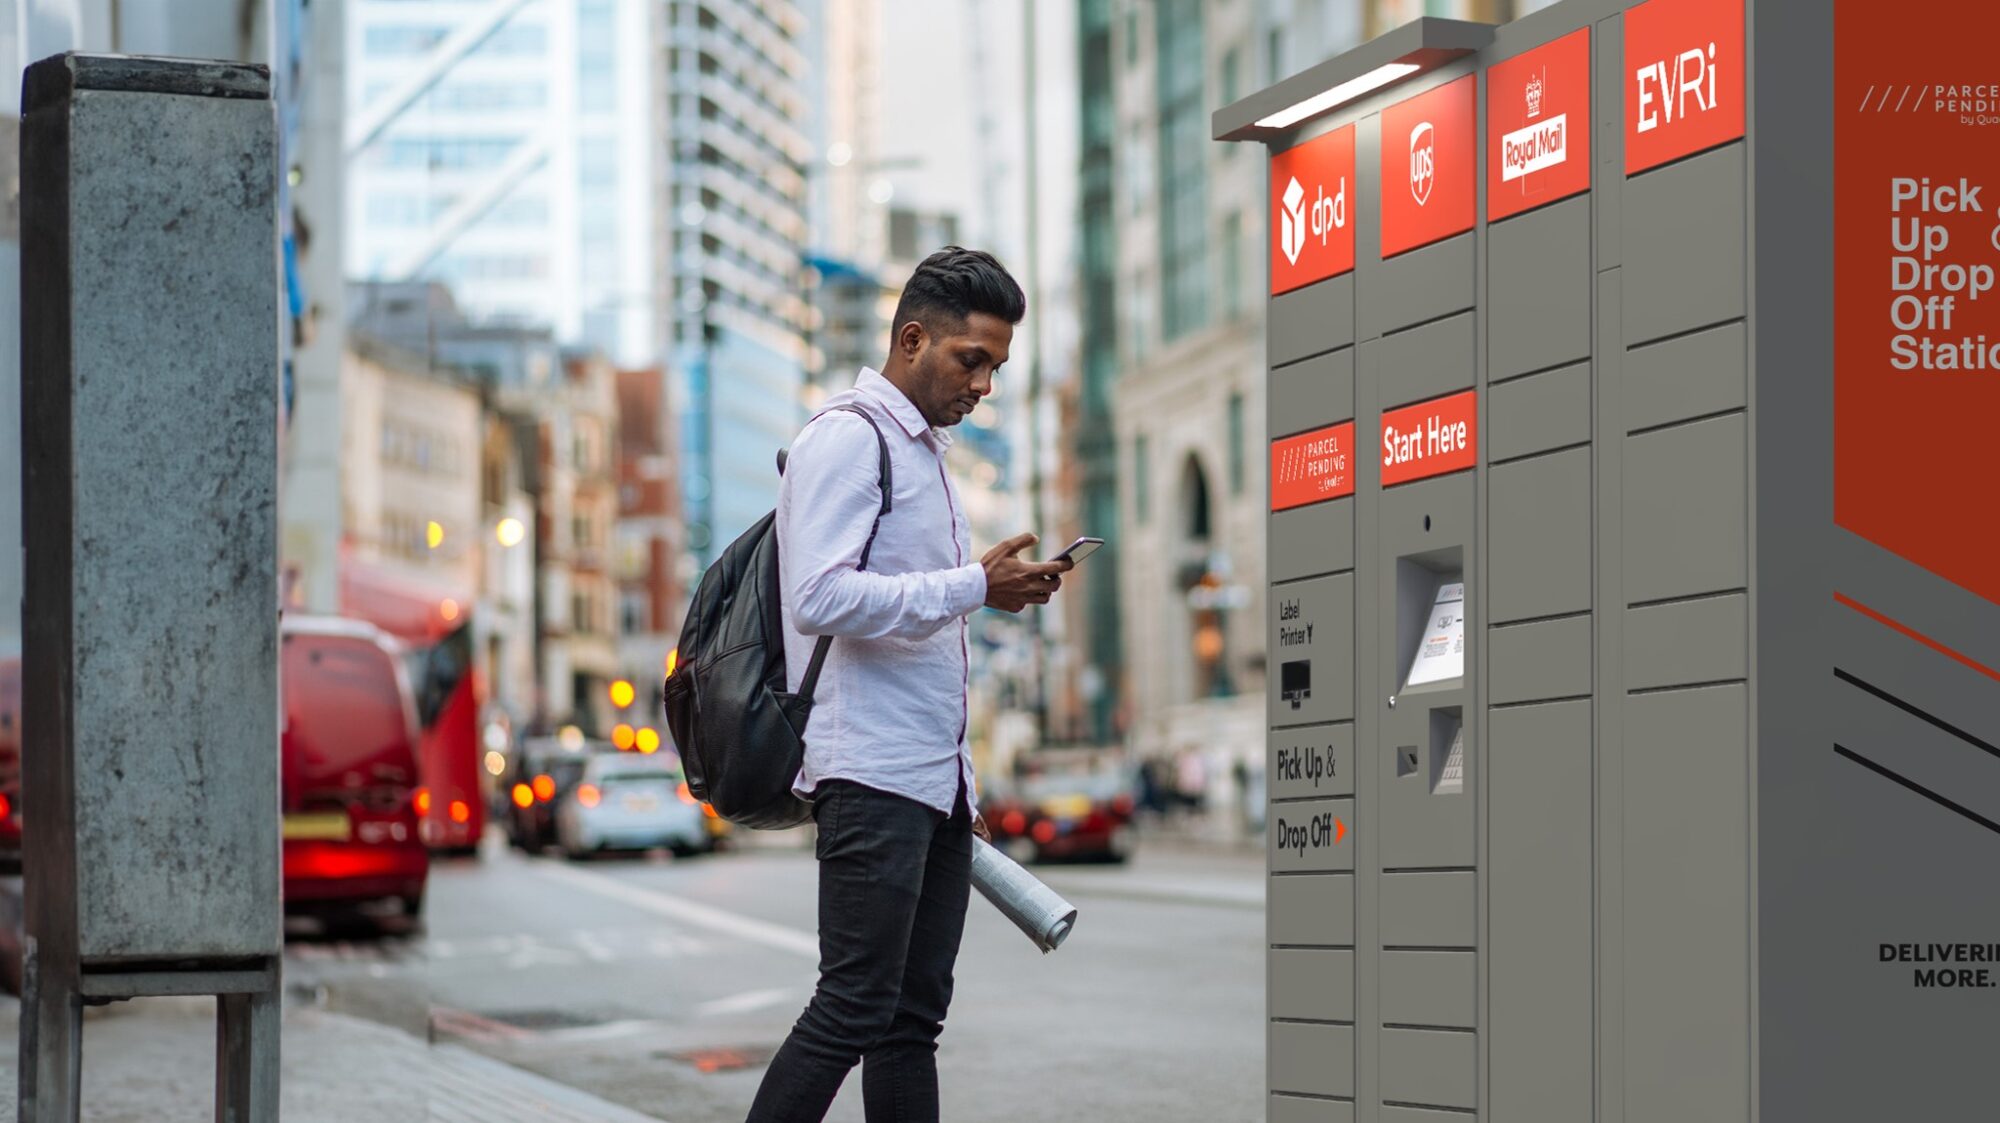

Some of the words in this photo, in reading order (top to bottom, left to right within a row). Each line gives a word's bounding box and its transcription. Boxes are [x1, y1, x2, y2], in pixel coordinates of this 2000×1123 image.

[1935, 100, 2000, 112] PENDI
[1961, 113, 1974, 126] by
[1976, 114, 2000, 126] Qua
[1506, 132, 1536, 170] Royal
[1539, 123, 1563, 156] Mail
[1411, 146, 1433, 193] ups
[1311, 176, 1345, 247] dpd
[1892, 177, 1983, 213] Pick
[1892, 217, 1949, 260] Up
[1892, 256, 1994, 300] Drop
[1890, 295, 1955, 330] Off
[1308, 437, 1338, 459] PARCEL
[1384, 424, 1423, 466] Start
[1427, 415, 1467, 457] Here
[1308, 454, 1346, 477] PENDING
[1280, 598, 1300, 620] Label
[1280, 625, 1305, 647] Printer
[1278, 746, 1301, 781] Pick
[1305, 746, 1323, 788] Up
[1326, 744, 1336, 778] &
[1278, 818, 1308, 858] Drop
[1311, 812, 1332, 848] Off
[1879, 943, 2000, 962] DELIVERI
[1914, 968, 1996, 988] MORE.
